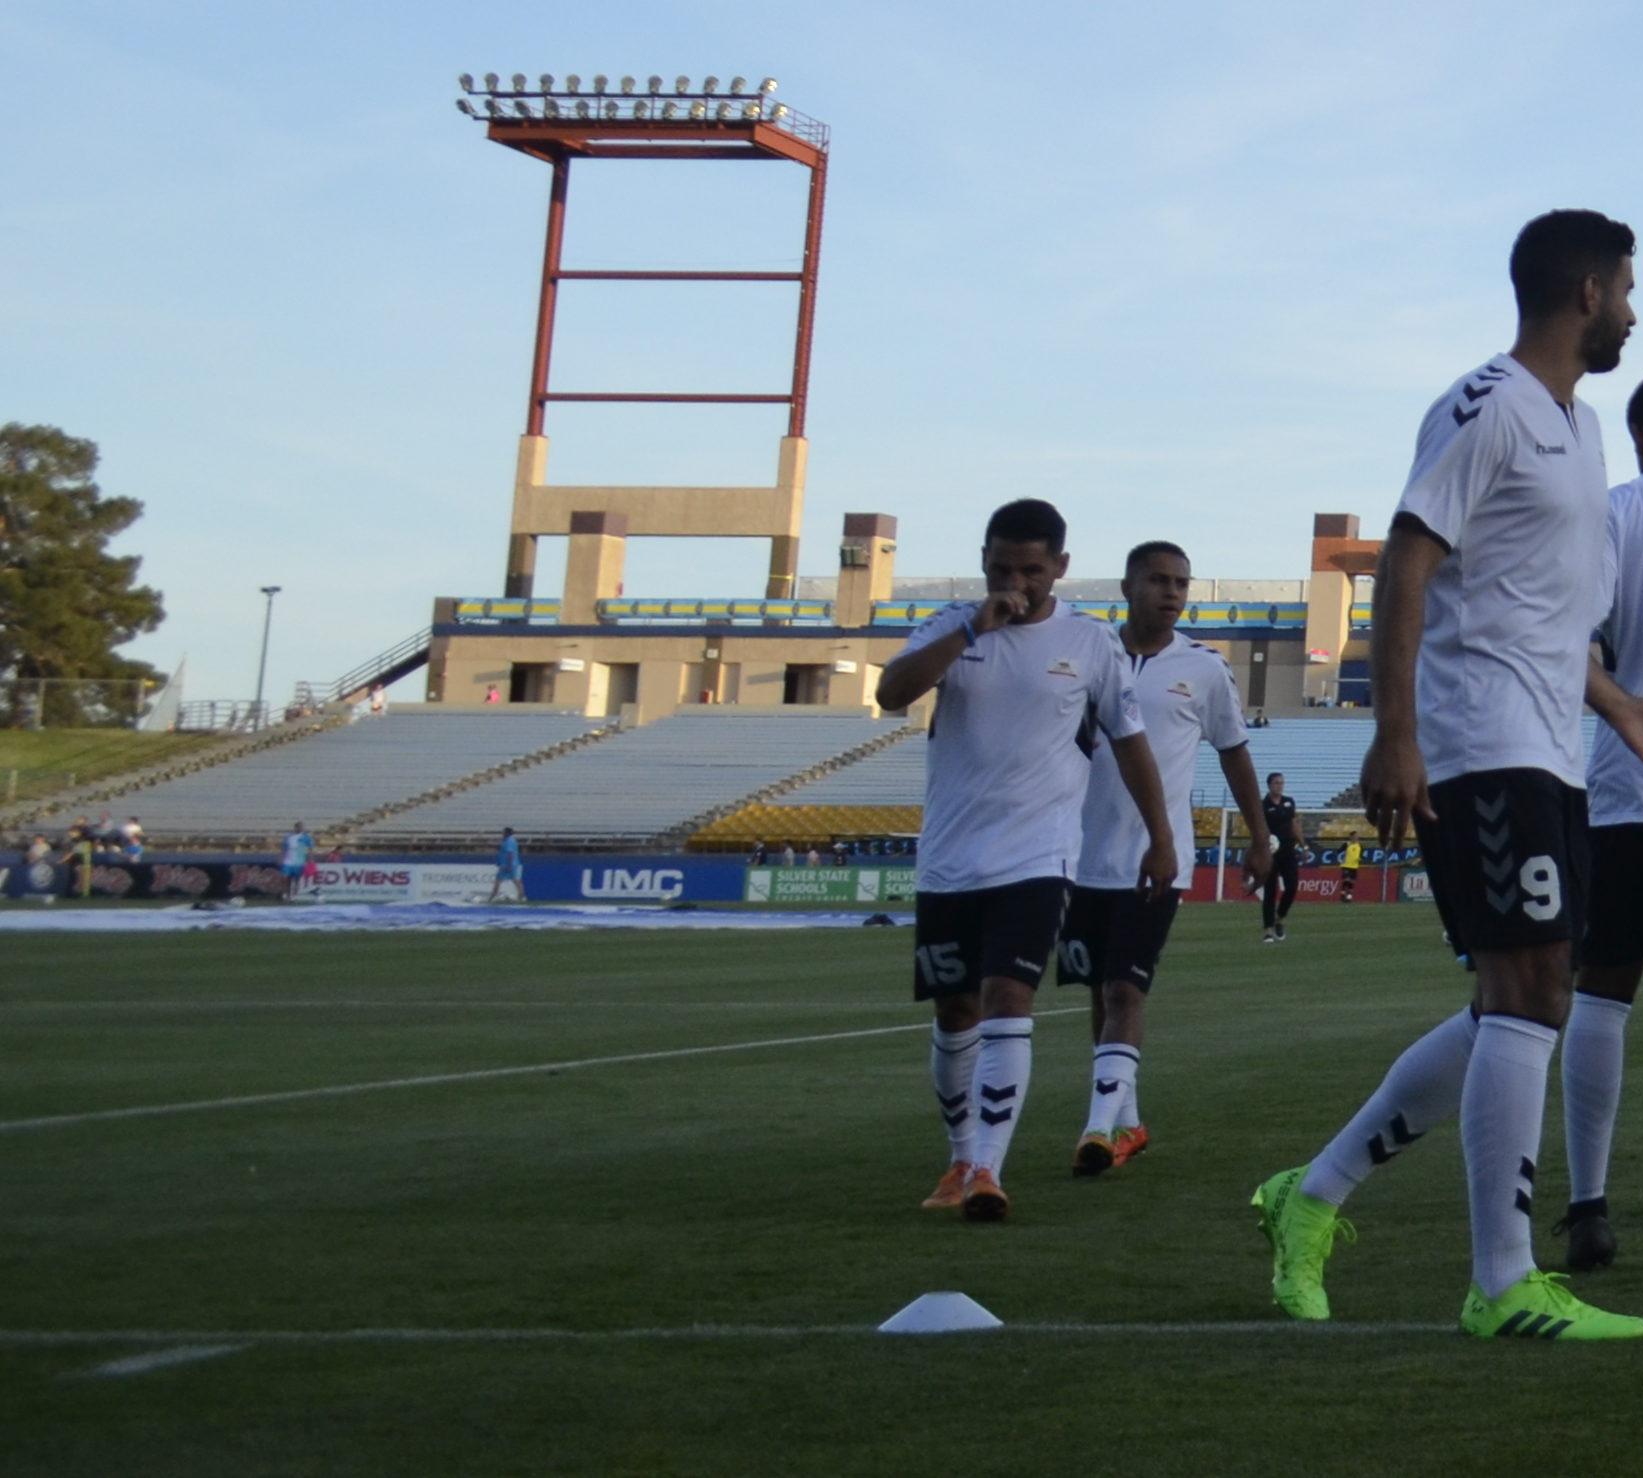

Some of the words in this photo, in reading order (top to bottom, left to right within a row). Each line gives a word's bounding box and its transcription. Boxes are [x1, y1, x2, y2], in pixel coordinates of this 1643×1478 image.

[580, 867, 684, 898] UMC
[776, 870, 816, 882] SILVER
[817, 870, 850, 882] STATE
[886, 870, 917, 882] SILVE
[775, 882, 828, 894] SCHOOLS
[884, 882, 916, 895] SCHO
[1295, 877, 1338, 895] nergy
[1518, 854, 1562, 922] 9
[916, 941, 967, 987] 15
